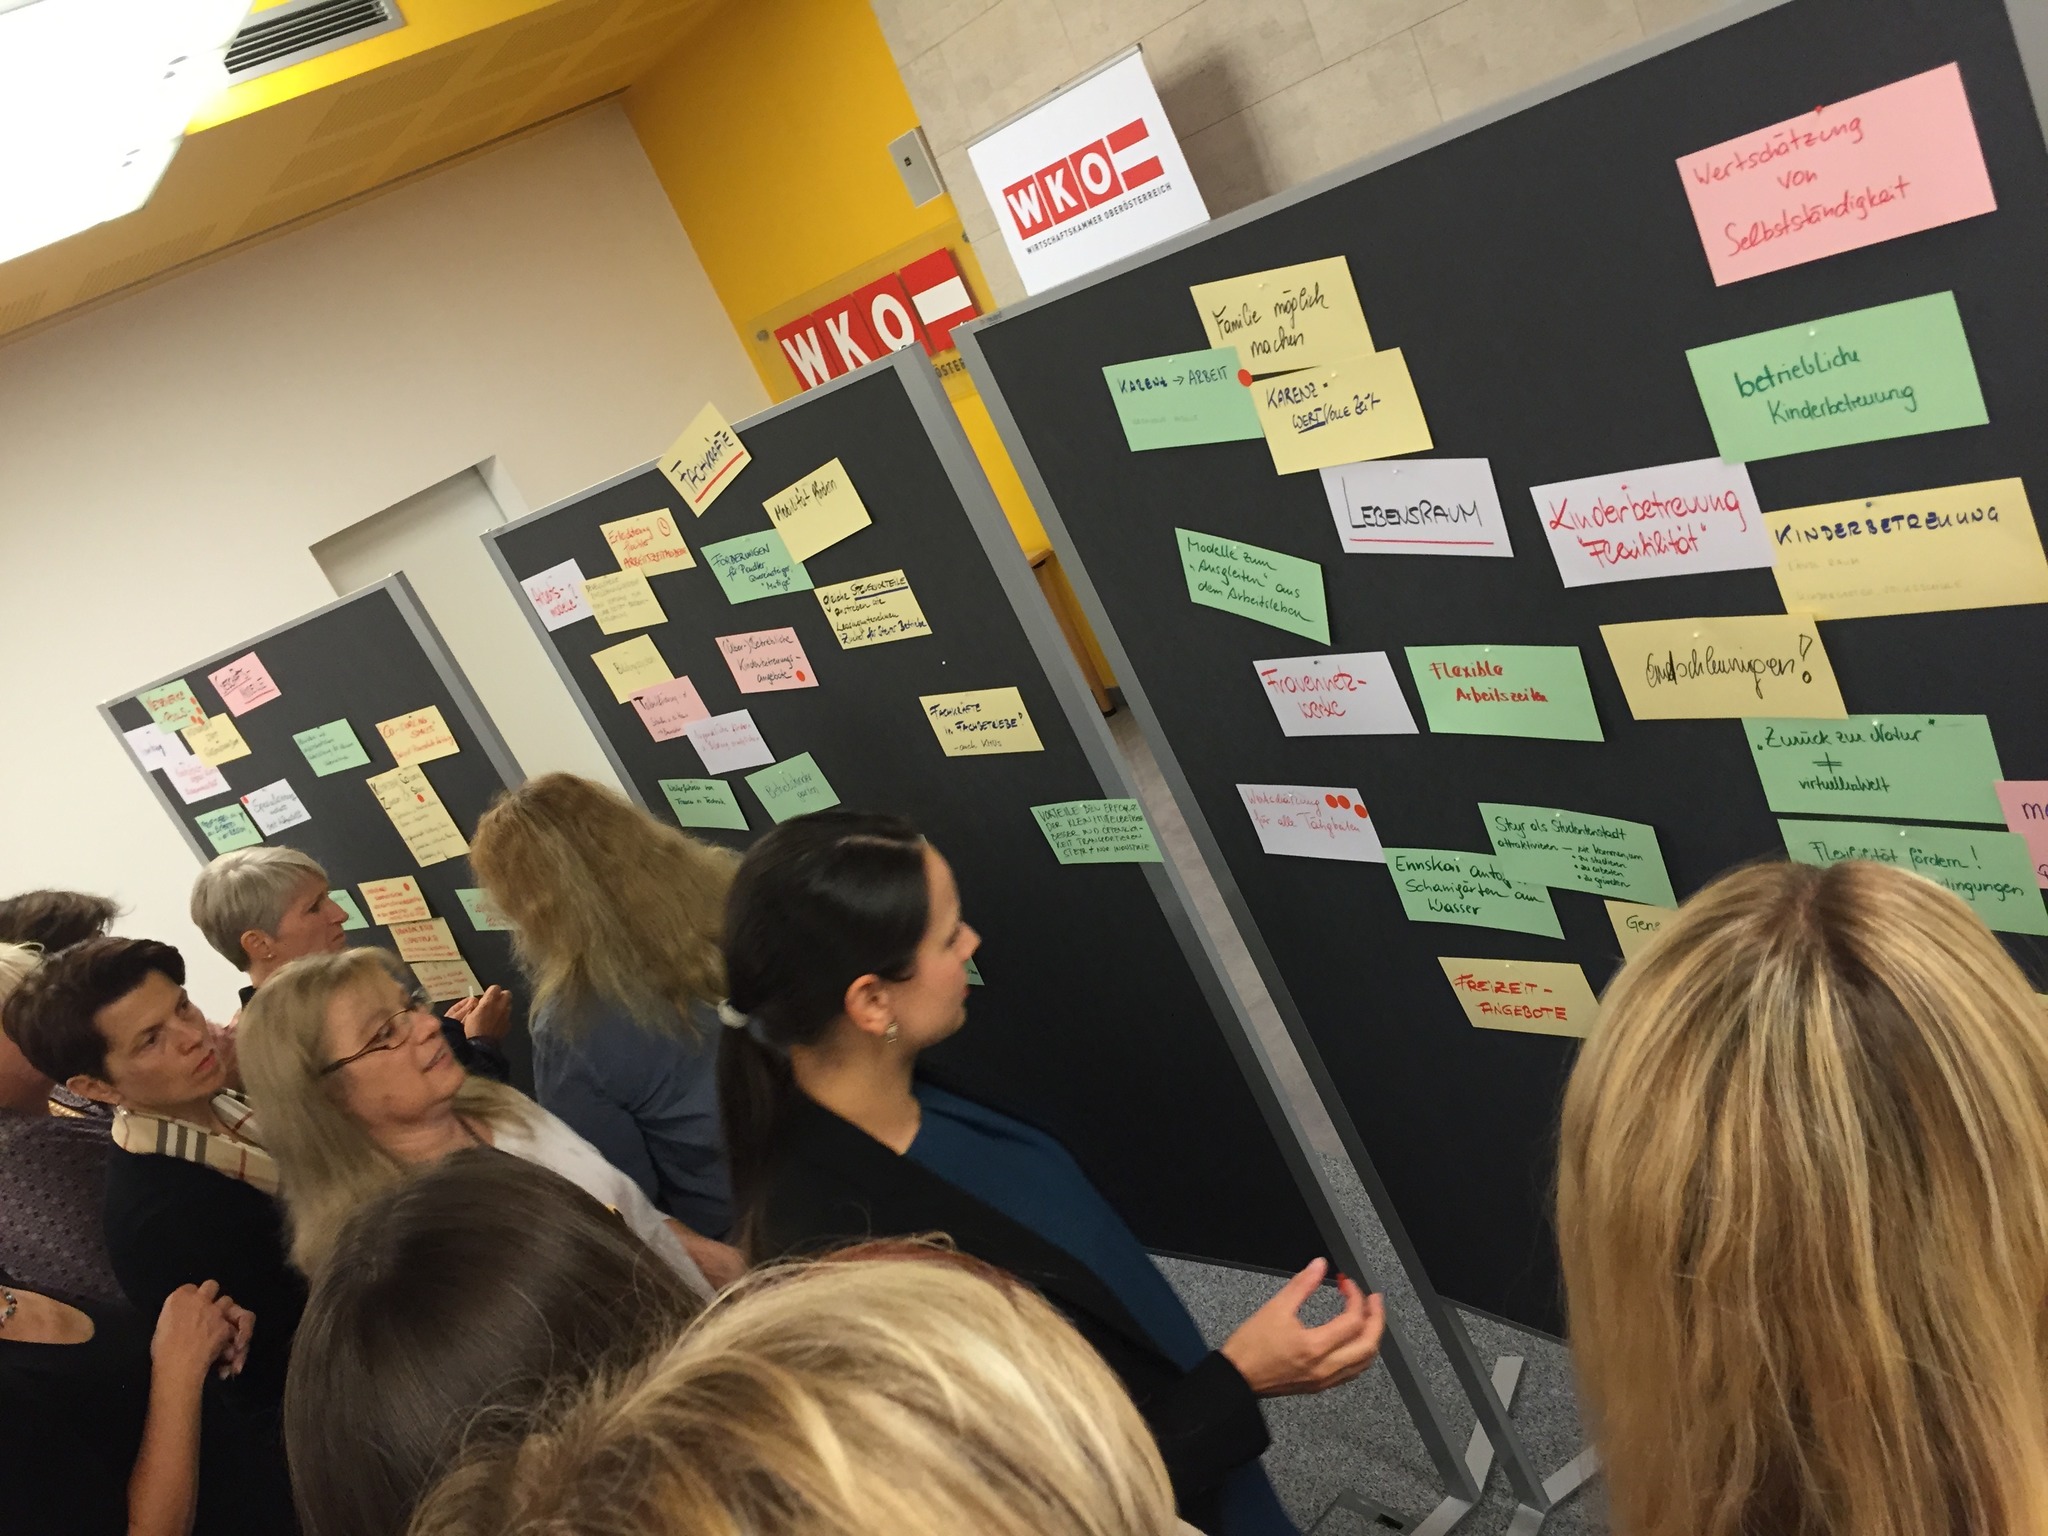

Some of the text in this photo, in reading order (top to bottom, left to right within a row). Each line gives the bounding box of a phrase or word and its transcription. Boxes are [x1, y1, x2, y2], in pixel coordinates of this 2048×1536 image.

[1007, 152, 1112, 230] WKO
[1777, 168, 1818, 190] von
[1026, 182, 1173, 255] WIRTSCHAFTSKAMMER OBERÖSTERREICH
[1724, 176, 1911, 256] Selbstständigkeit
[1211, 282, 1330, 341] Familie möglich
[1250, 332, 1305, 360] machen
[1188, 365, 1229, 386] ARBEIT
[1734, 345, 1862, 398] betriebliche
[1766, 384, 1917, 425] Kinderbetreuung
[1342, 476, 1484, 529] LEBENSRAUM
[1549, 490, 1747, 533] Kinderbetreuung
[1774, 506, 2000, 546] KINDERBETREUUNG
[1187, 536, 1278, 572] Modelle zum
[1197, 581, 1223, 596] dem
[1275, 583, 1301, 599] aus
[1429, 660, 1503, 681] Flexible
[1530, 818, 1549, 833] als
[1428, 897, 1483, 916] Wasser
[1475, 1001, 1568, 1021] ANGEBOTE
